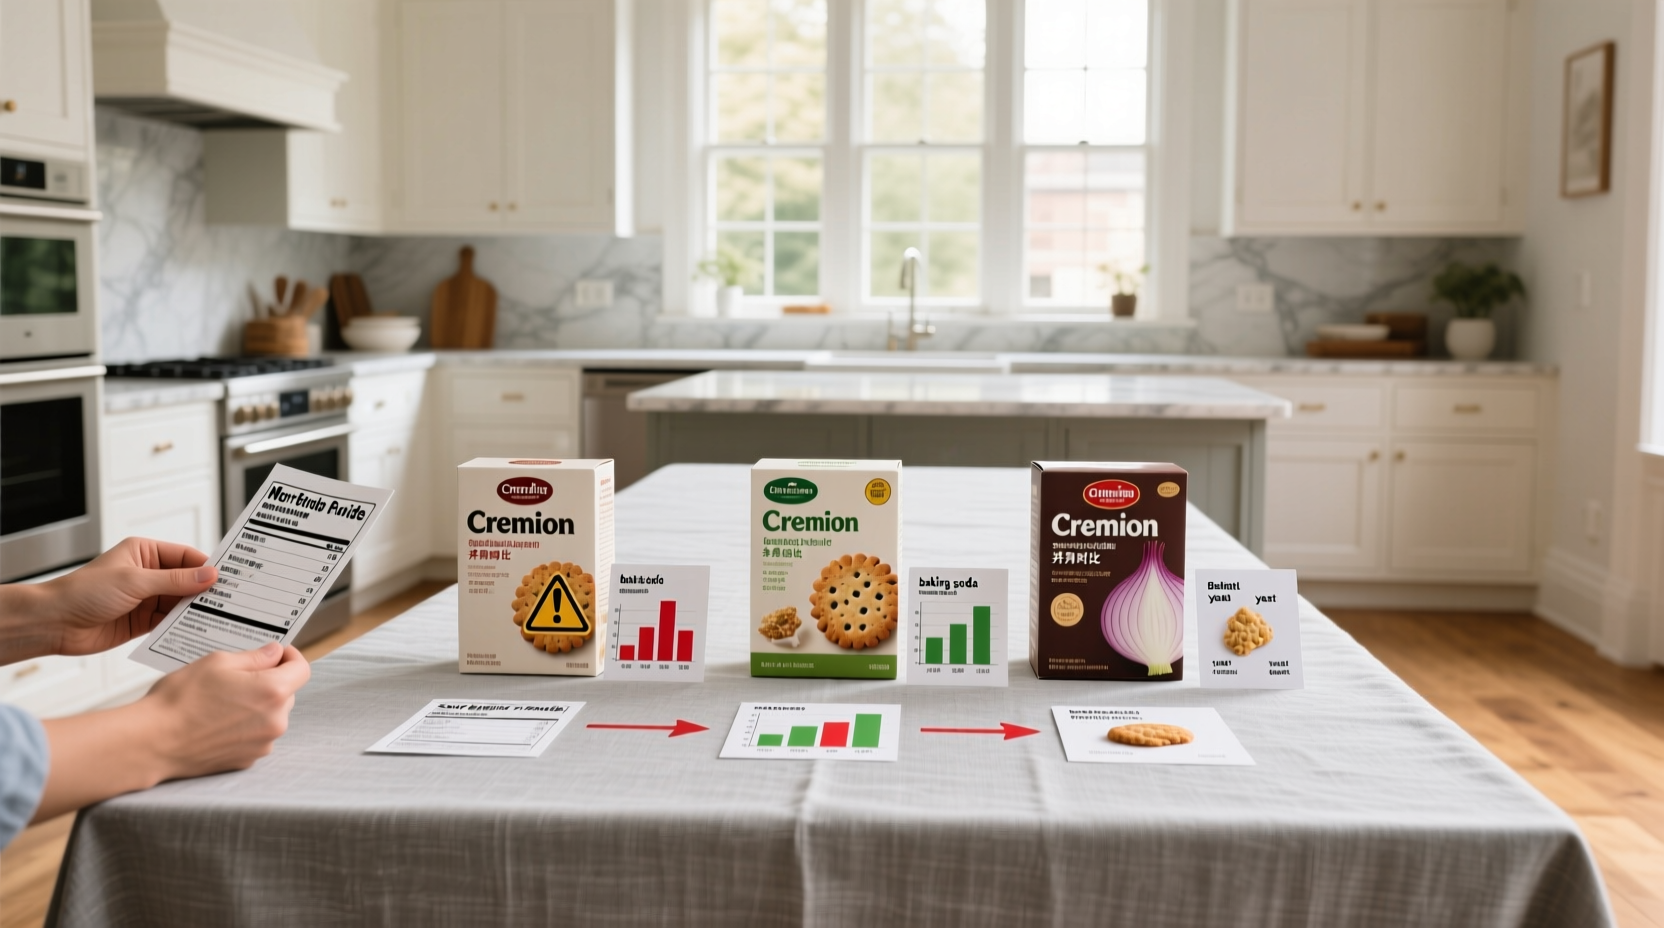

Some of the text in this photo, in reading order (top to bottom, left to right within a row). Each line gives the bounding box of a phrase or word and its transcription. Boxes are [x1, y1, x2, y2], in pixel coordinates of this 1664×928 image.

[467, 510, 575, 535] Cremion
[762, 510, 859, 532] Cremion
[1051, 512, 1158, 537] Cremion
[953, 576, 978, 588] soda
